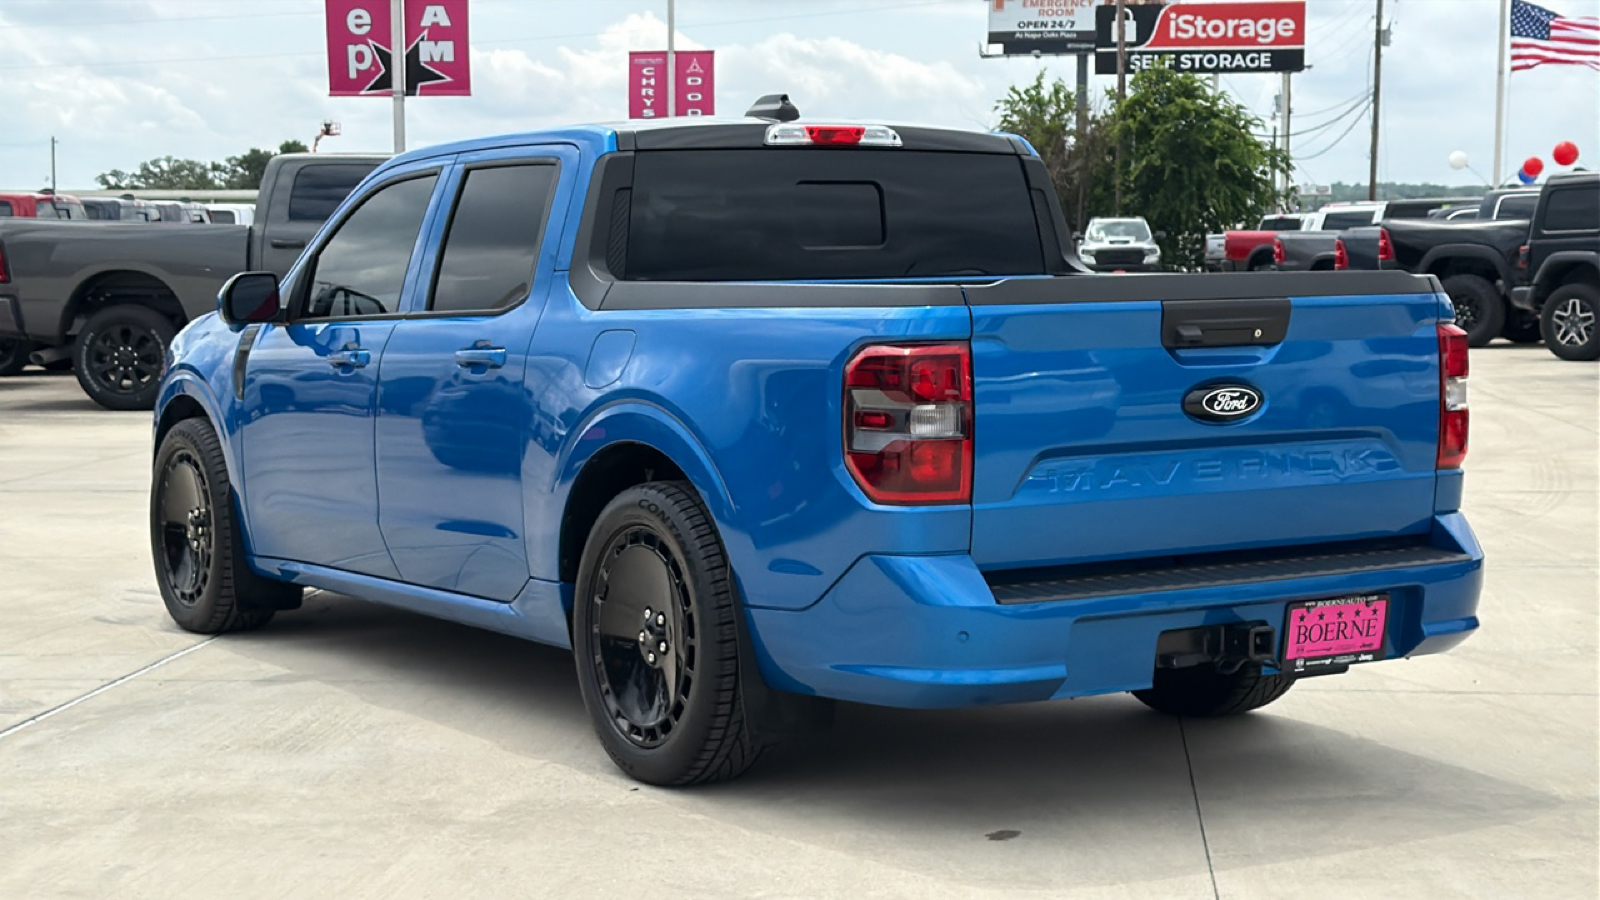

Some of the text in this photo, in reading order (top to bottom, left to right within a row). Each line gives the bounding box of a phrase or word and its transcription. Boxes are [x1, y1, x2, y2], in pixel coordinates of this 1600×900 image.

[1038, 8, 1075, 17] ROOM
[1017, 20, 1076, 29] OPEN 24/7
[1169, 12, 1296, 43] iStorage
[1130, 53, 1272, 70] SELF STORAGE
[1213, 391, 1249, 411] Ford
[1047, 448, 1376, 494] MAVERICK
[1295, 618, 1379, 645] BOERNE
